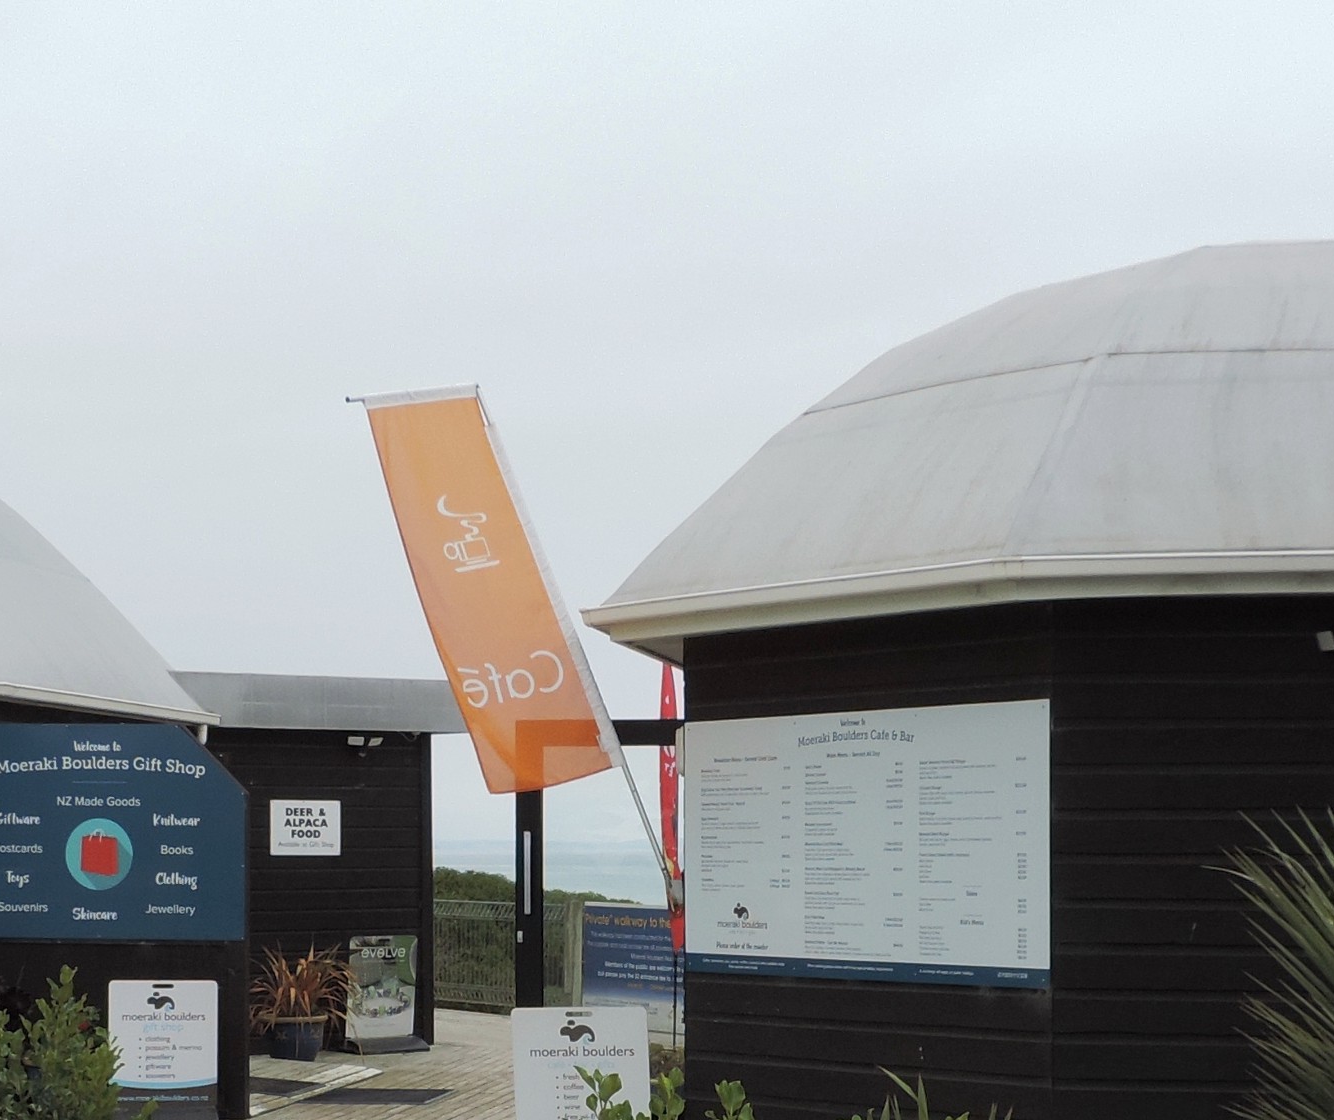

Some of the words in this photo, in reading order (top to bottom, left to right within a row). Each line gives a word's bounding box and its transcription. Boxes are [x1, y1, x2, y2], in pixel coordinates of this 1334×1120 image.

[798, 732, 830, 748] Moeraki
[832, 730, 868, 742] Boulders
[870, 729, 890, 741] Cafe
[891, 730, 898, 741] &
[899, 730, 915, 743] Bar
[73, 740, 111, 752] Welcome
[113, 740, 122, 752] to
[62, 756, 129, 771] Boulders
[133, 756, 162, 772] Gift
[165, 759, 206, 778] Shop
[57, 796, 72, 807] NZ
[75, 796, 104, 807] Made
[106, 796, 141, 807] Goods
[285, 807, 314, 817] DEER
[319, 807, 326, 817] &
[153, 813, 200, 827] Knitwear
[284, 818, 328, 828] ALPACA
[291, 829, 321, 839] FOOD
[160, 844, 194, 855] Books
[5, 870, 30, 888] Toys
[155, 872, 198, 890] Clothing
[72, 907, 118, 921] Skincare
[145, 904, 196, 916] Jewellery
[649, 916, 658, 928] to
[121, 1012, 162, 1021] moeraki
[164, 1012, 206, 1021] boulders
[529, 1046, 578, 1057] moeraki
[582, 1045, 635, 1057] boulders
